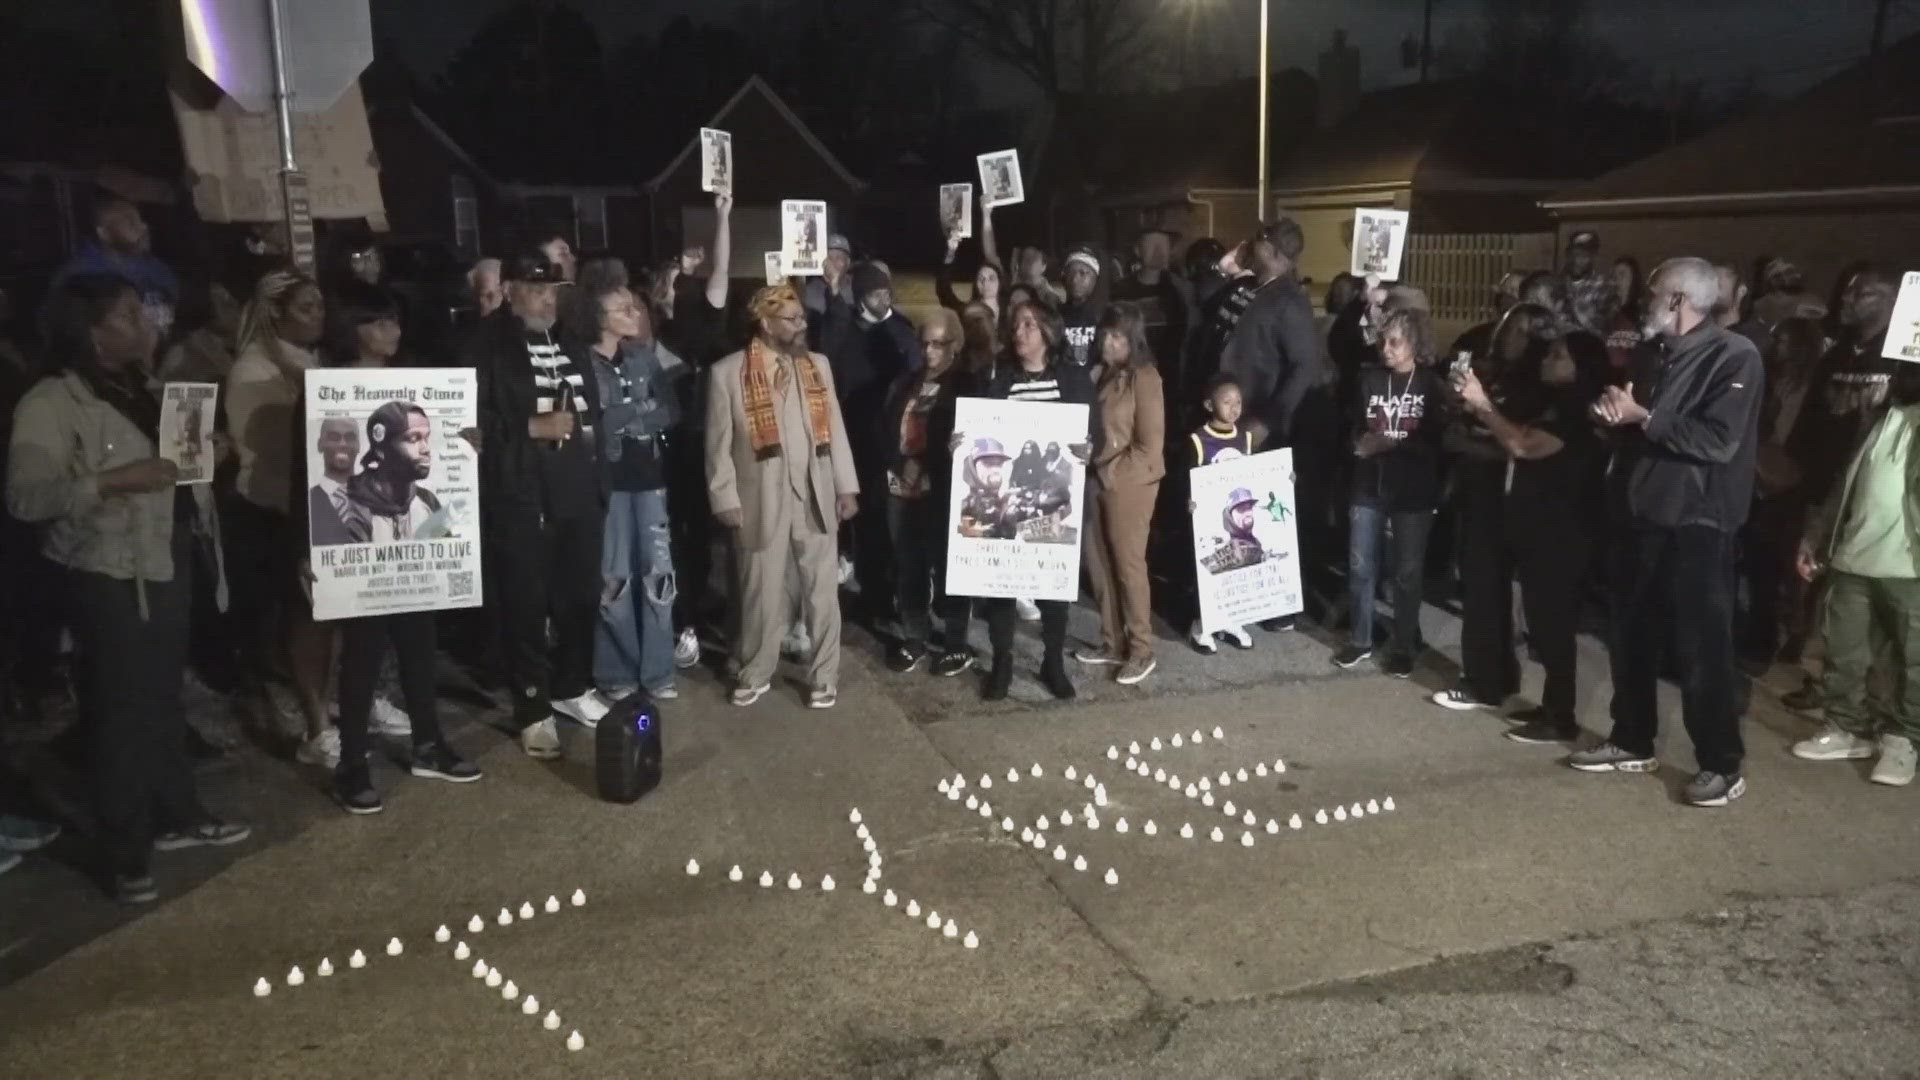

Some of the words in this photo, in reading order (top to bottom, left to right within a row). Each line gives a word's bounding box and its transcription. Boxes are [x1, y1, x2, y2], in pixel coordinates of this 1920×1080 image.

[318, 385, 346, 404] The
[353, 385, 417, 403] Heavenly
[422, 386, 465, 401] Times
[1369, 393, 1424, 406] BLACK
[1367, 407, 1423, 418] LVES
[321, 549, 337, 567] HE
[341, 547, 372, 566] JUST
[375, 543, 426, 563] WANTED
[429, 543, 445, 559] TO
[449, 541, 472, 558] LIVE
